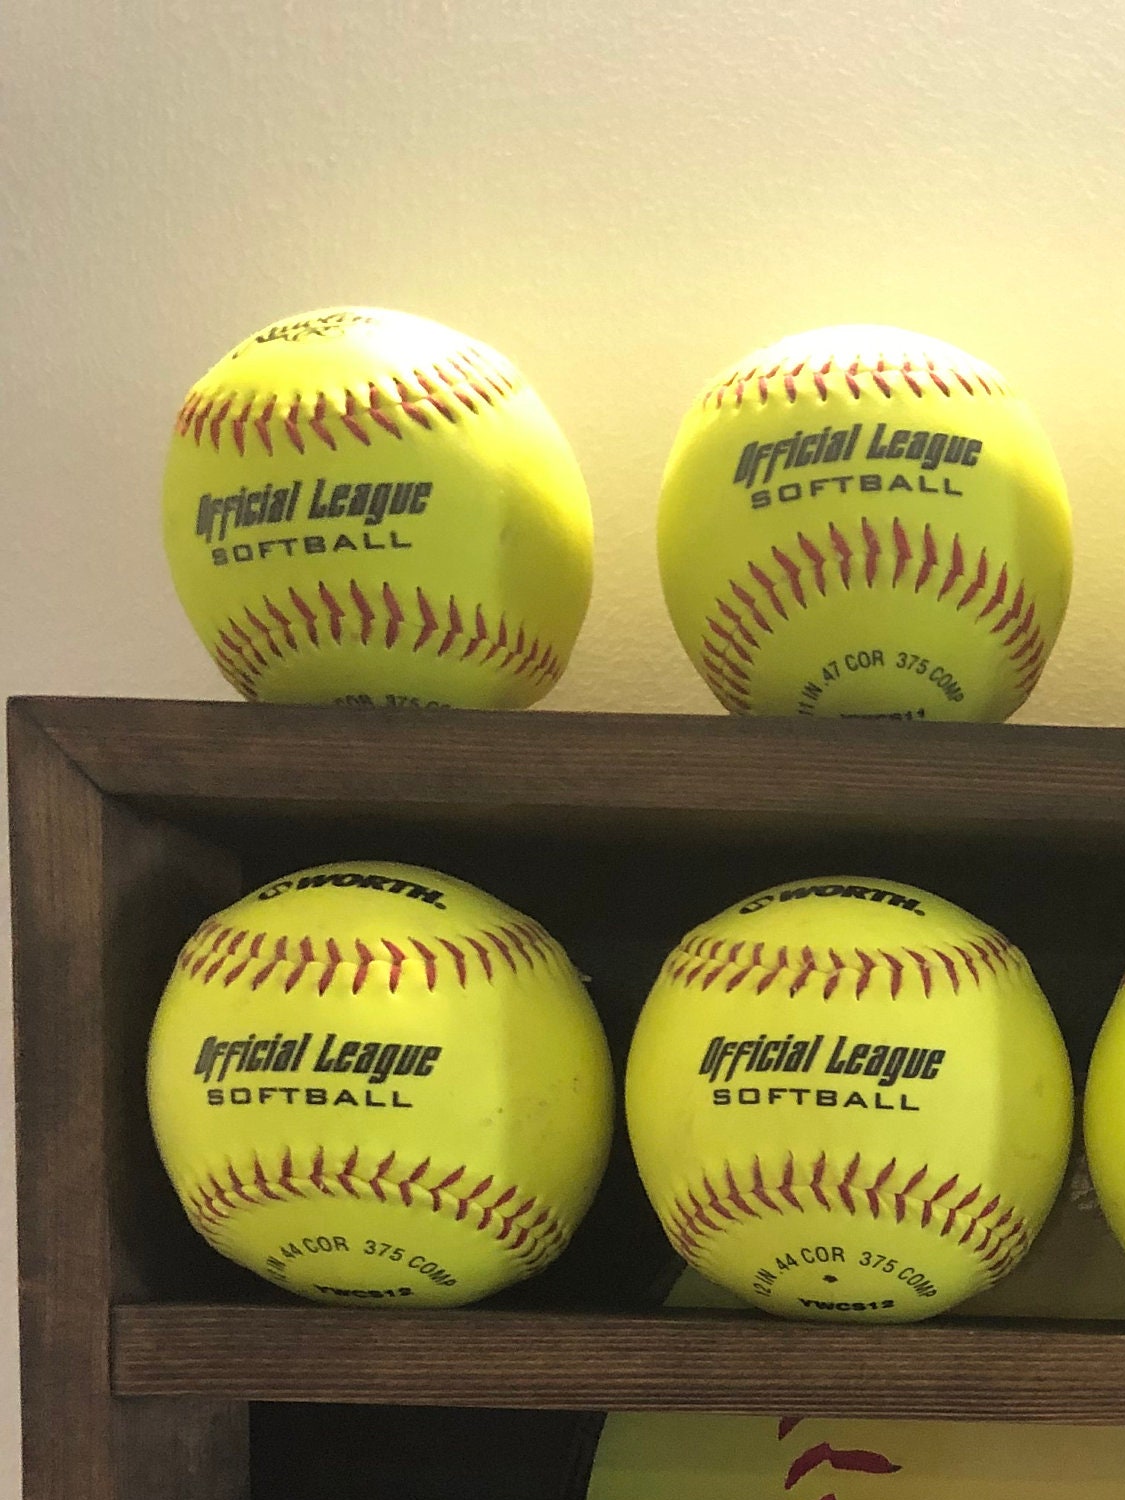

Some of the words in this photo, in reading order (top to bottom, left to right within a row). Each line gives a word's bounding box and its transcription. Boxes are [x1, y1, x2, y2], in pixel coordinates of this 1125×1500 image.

[733, 424, 862, 488] Official
[867, 423, 983, 470] League
[750, 474, 963, 509] SOFTBALL
[196, 480, 302, 542] Official
[308, 478, 433, 526] League
[211, 531, 412, 565] SOFTBALL
[802, 681, 823, 700] IN
[845, 650, 884, 671] COR
[896, 652, 930, 674] 375
[929, 666, 964, 702] COMP
[193, 1032, 313, 1084] Official
[313, 1033, 443, 1085] League
[698, 1034, 824, 1084] Official
[824, 1035, 946, 1087] League
[207, 1086, 413, 1108] SOFTBALL
[712, 1087, 920, 1112] SOFTBALL
[302, 1236, 350, 1253] COR
[363, 1240, 406, 1262] 375
[408, 1256, 459, 1287] COMP
[800, 1246, 845, 1264] COR
[859, 1251, 898, 1273] 375
[753, 1283, 772, 1297] 12
[755, 1268, 777, 1285] IN
[897, 1267, 937, 1298] COMP
[798, 1298, 895, 1311] YWCS12
